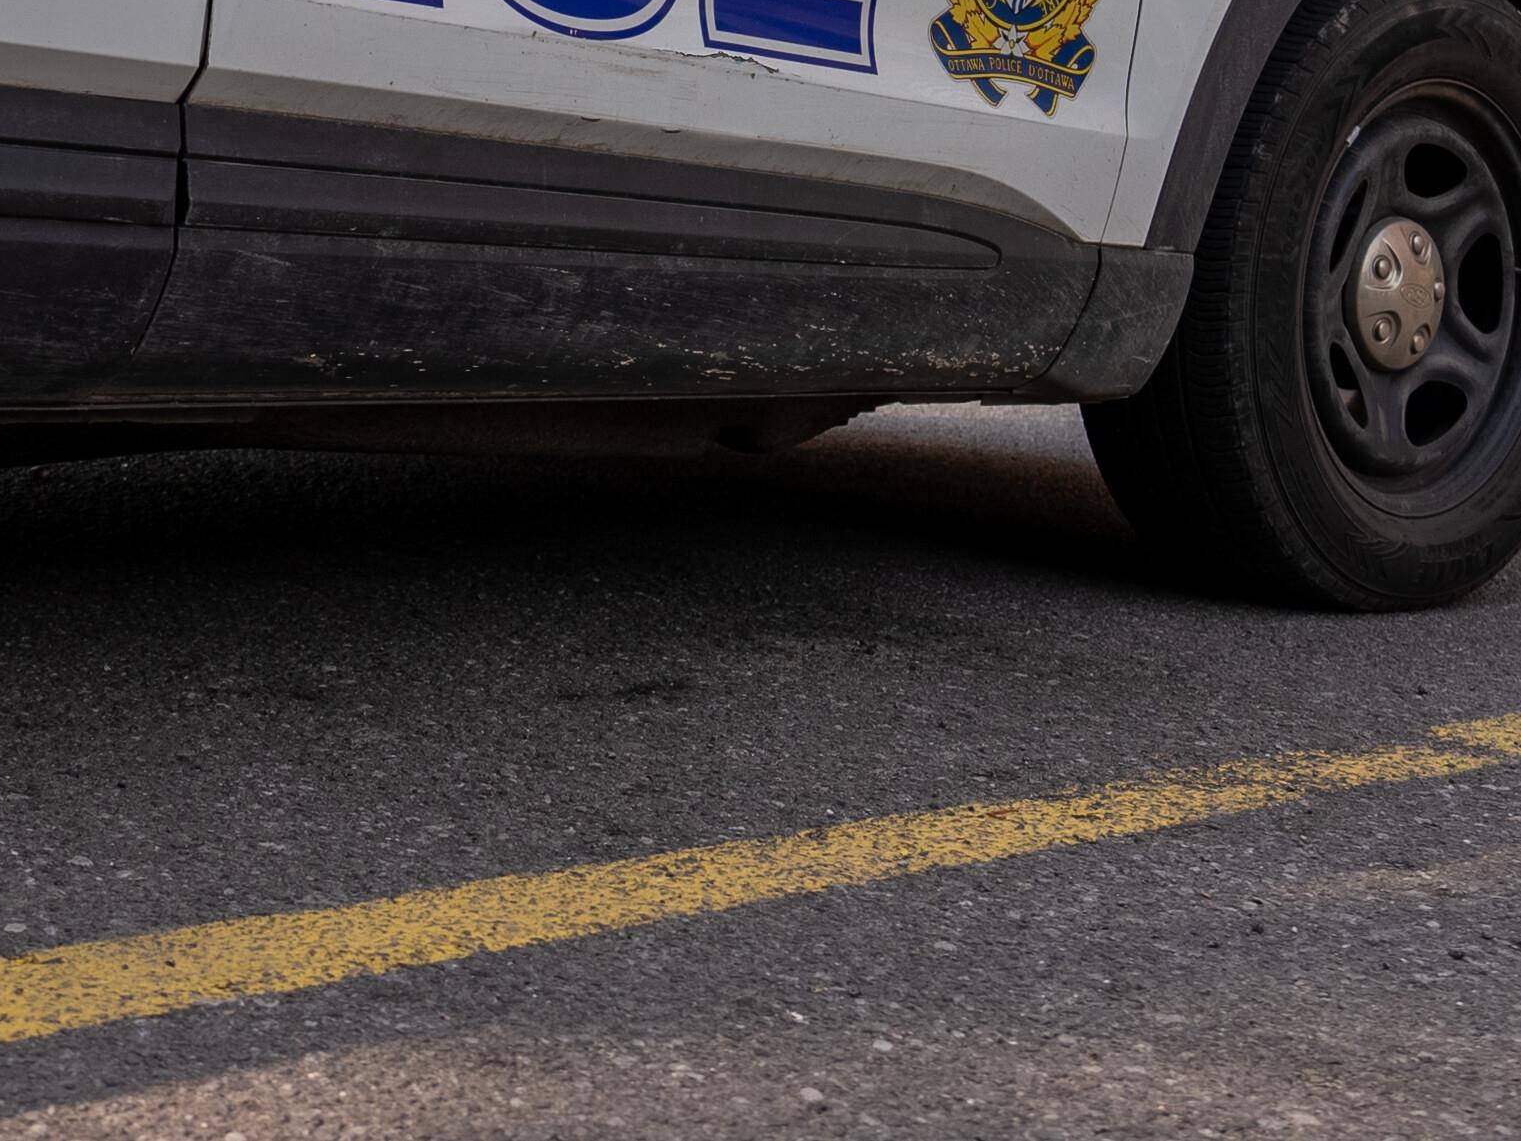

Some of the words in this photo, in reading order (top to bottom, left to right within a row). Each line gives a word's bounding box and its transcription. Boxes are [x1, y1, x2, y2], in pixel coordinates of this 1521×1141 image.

[947, 56, 985, 72] OTTAWA
[988, 56, 1023, 75] POLICE
[1028, 66, 1076, 91] D'OTTAWA
